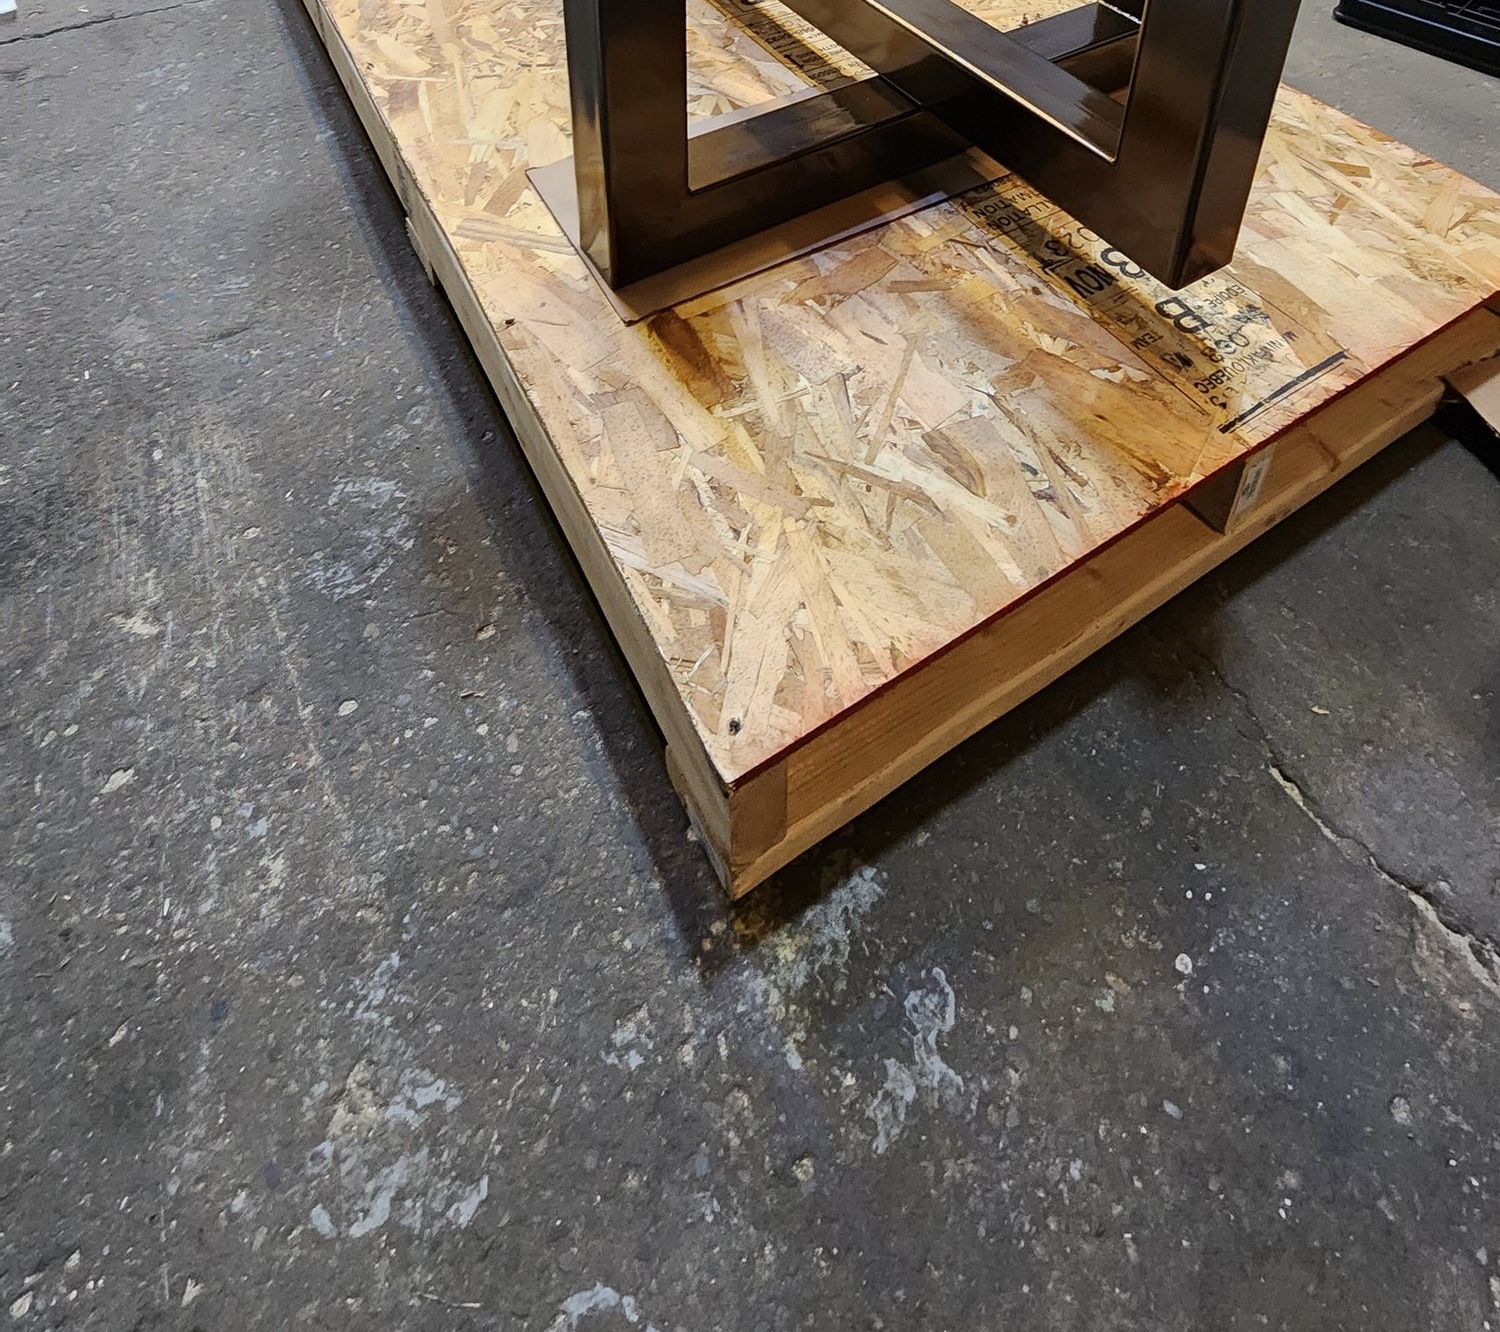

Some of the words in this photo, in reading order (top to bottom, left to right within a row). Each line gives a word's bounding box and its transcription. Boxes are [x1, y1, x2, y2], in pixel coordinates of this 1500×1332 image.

[1041, 222, 1101, 261] 023
[1060, 259, 1119, 300] NOV
[1150, 292, 1213, 339] B
[1128, 327, 1164, 351] TEAM
